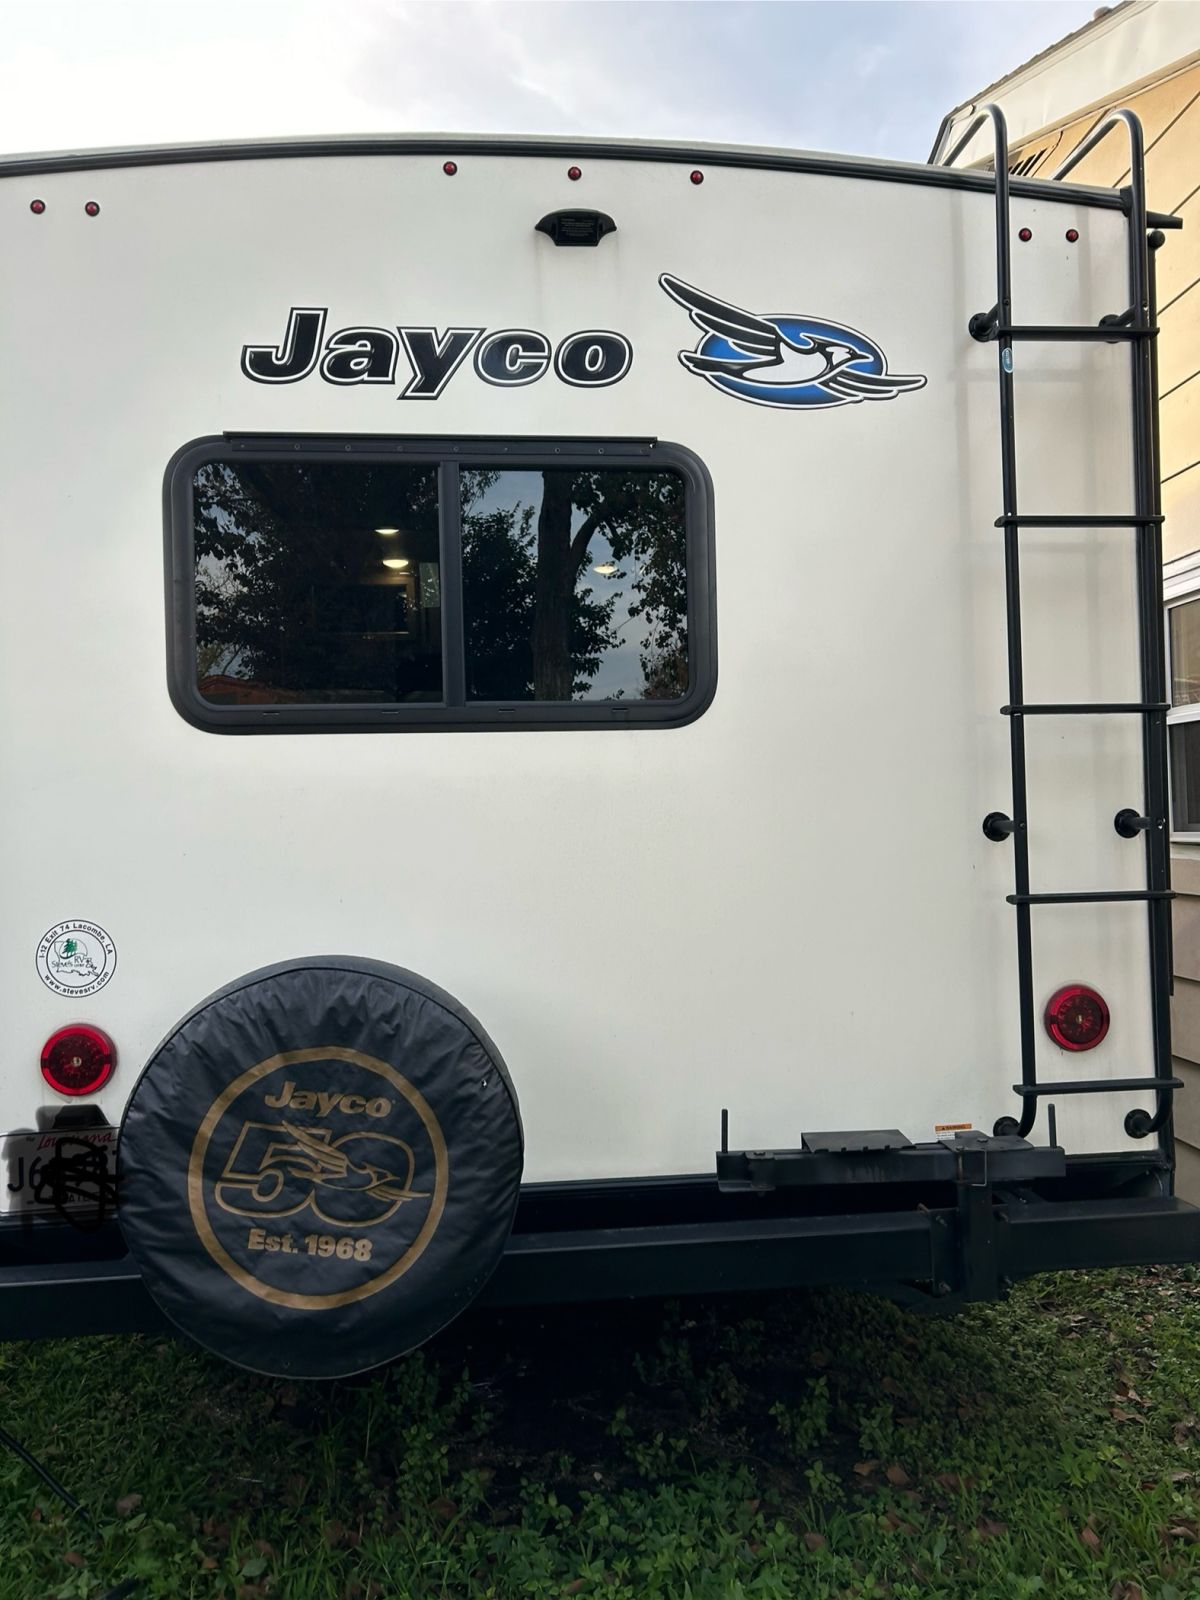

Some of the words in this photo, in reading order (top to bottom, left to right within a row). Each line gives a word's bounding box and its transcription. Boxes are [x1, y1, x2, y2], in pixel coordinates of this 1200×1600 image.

[240, 307, 634, 400] Jayco
[45, 930, 58, 943] Exit
[60, 924, 70, 932] 74
[73, 922, 106, 943] Lacombe,
[105, 943, 113, 955] LA
[44, 971, 109, 995] www.stevesrv.com
[265, 1081, 392, 1118] Jayco
[248, 1228, 298, 1254] Est.
[304, 1234, 373, 1262] 1968
